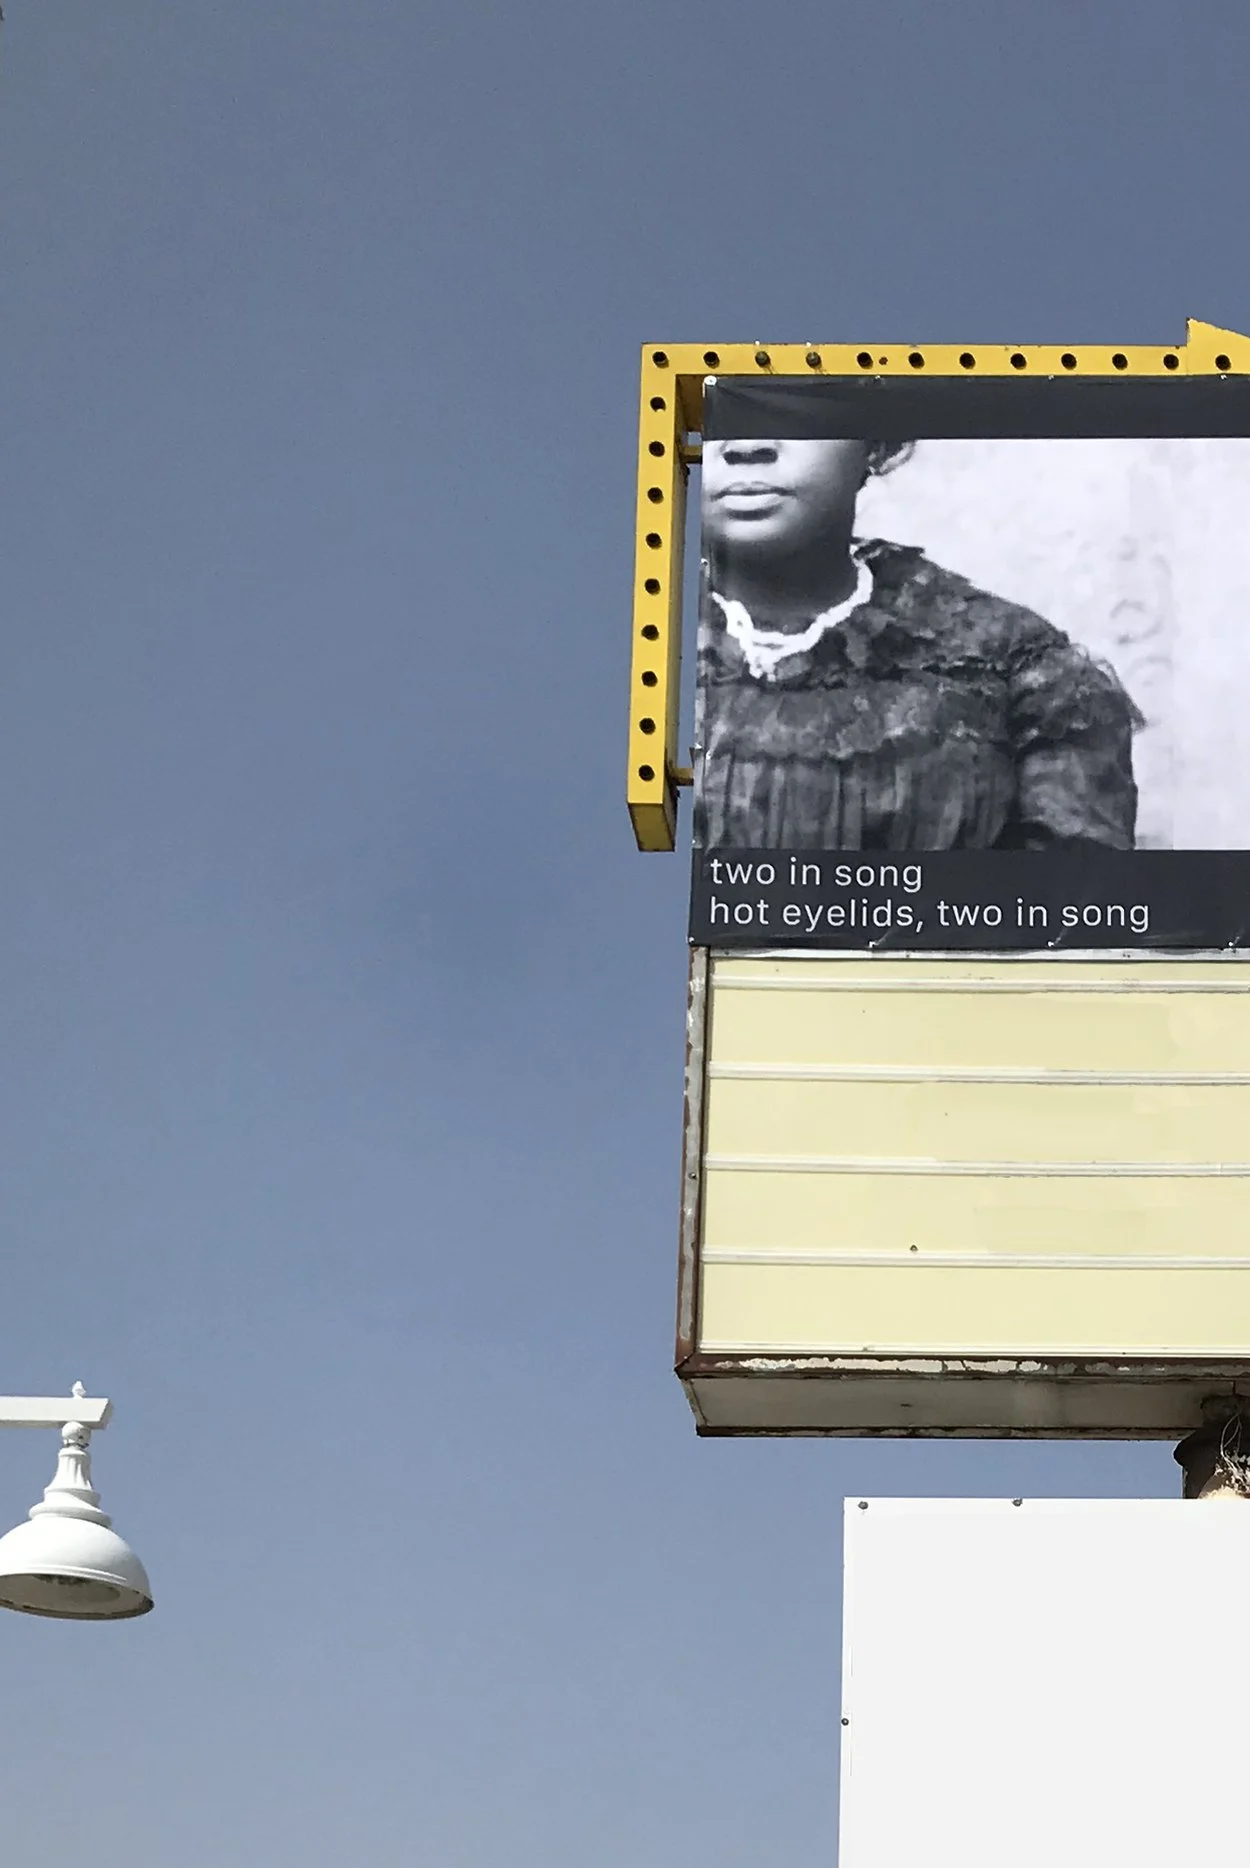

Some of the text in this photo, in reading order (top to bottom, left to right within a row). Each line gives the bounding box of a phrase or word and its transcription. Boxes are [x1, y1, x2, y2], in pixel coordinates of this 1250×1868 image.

[710, 857, 923, 893] two in song
[709, 897, 1151, 933] hot eyelids, two in song
